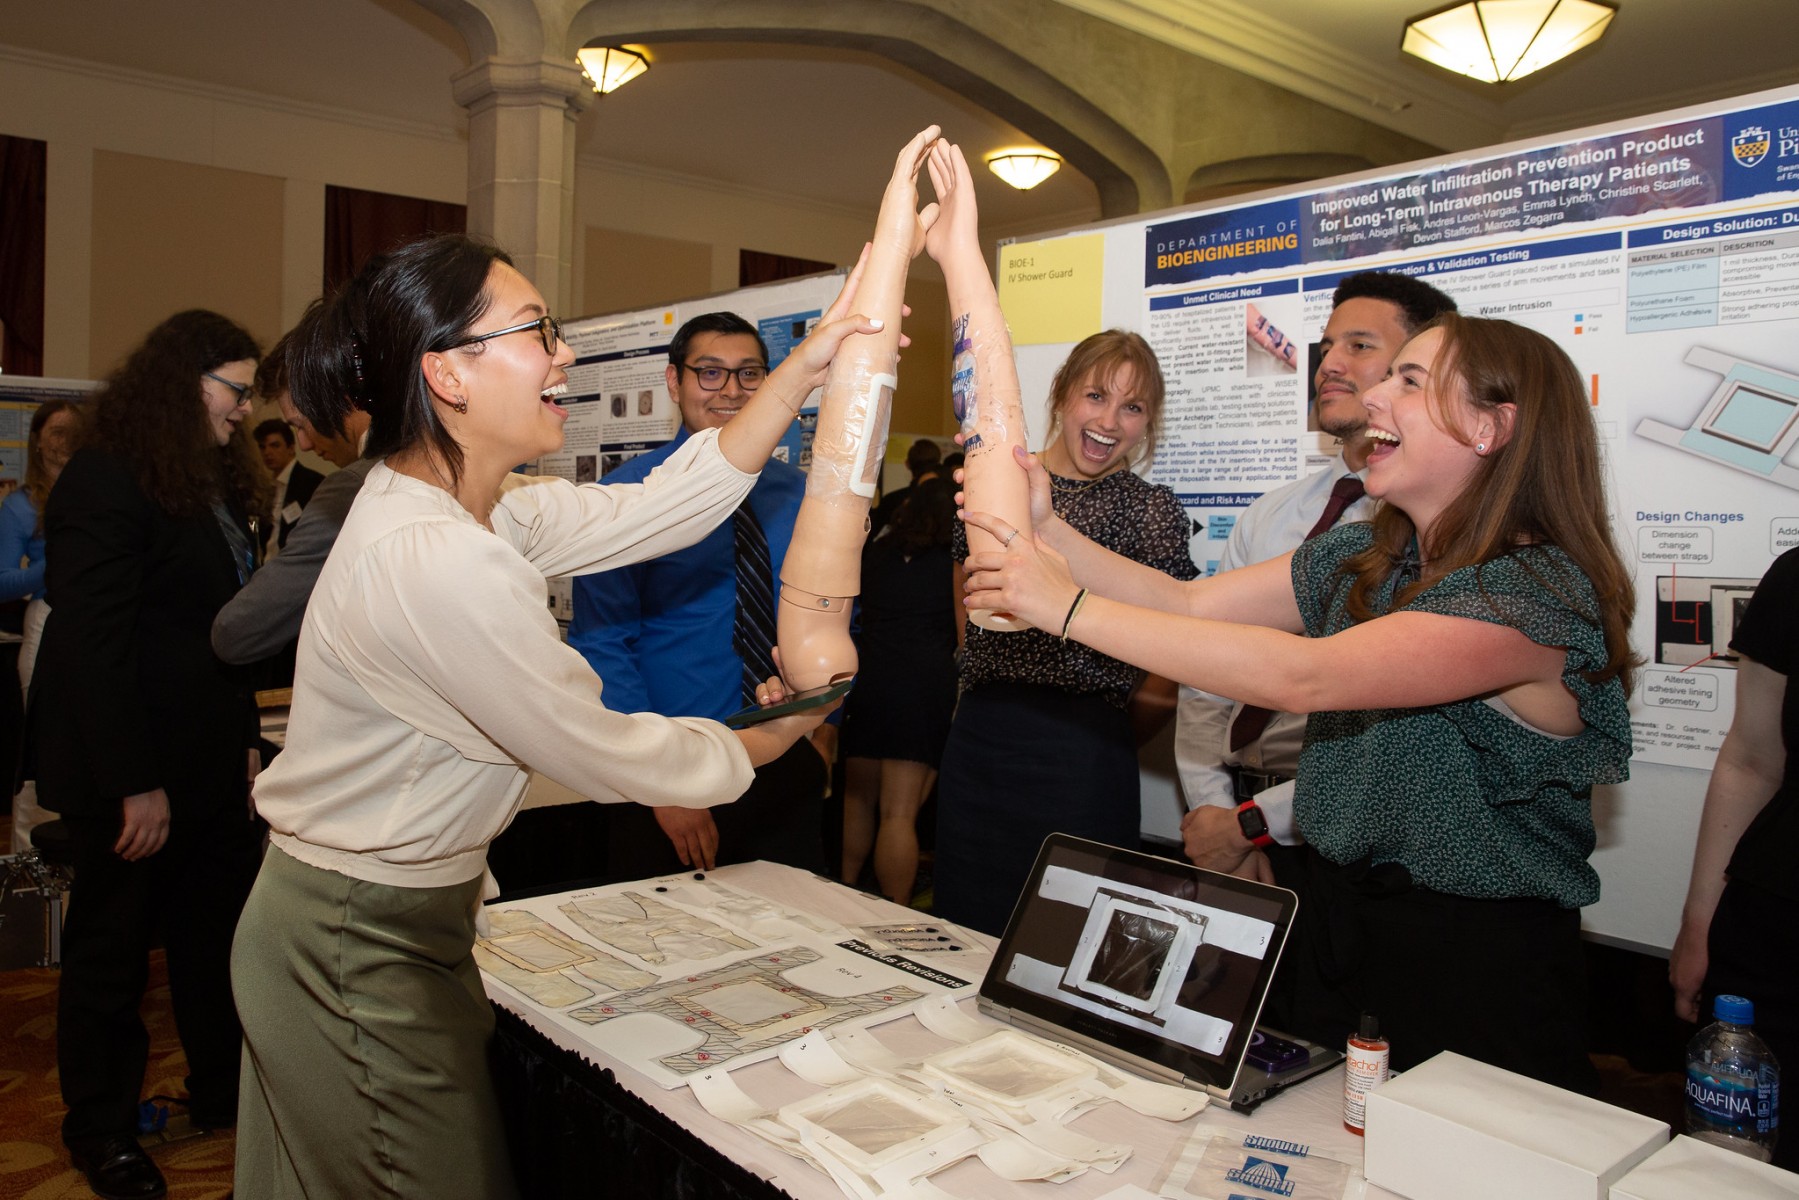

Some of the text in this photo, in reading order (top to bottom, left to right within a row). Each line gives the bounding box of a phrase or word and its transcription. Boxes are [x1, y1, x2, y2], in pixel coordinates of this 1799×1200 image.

[1312, 128, 1704, 215] Improved Water Infiltration Prevention Product
[1320, 157, 1691, 232] for Long-Term Intravenous Therapy Patients
[1313, 174, 1703, 247] Dalia Fantini, Abigail Fisk, Andres Leon-Vargas, Emma Lynch, Christine Scarlett,
[1413, 211, 1564, 244] Devon Stafford, Marcos Zegarra
[1663, 227, 1709, 240] Design
[1713, 216, 1778, 233] Solution:
[1157, 220, 1297, 252] DEPARTMENT OF
[1157, 234, 1298, 269] BIOENGINEERING
[1723, 240, 1774, 251] DESCRITION
[1427, 250, 1530, 272] & Validation Testing
[1631, 247, 1714, 263] MATERIAL SELECTION
[1009, 258, 1034, 268] BIOE-1
[1009, 268, 1073, 283] IV Shower Guard
[1183, 287, 1262, 305] Unmet Clinical Need
[1479, 300, 1552, 315] Water Intrusion
[1216, 496, 1233, 504] Risk
[1636, 511, 1744, 524] Design Changes
[1652, 530, 1698, 539] Dimension
[1658, 542, 1691, 550] change
[1642, 552, 1708, 561] between straps
[1664, 675, 1696, 685] Altered
[1648, 685, 1712, 698] adhesive lining
[1659, 697, 1700, 708] geometry
[1259, 936, 1265, 945] 3
[897, 961, 965, 989] Revisions
[1685, 1077, 1752, 1117] AQUAFINA
